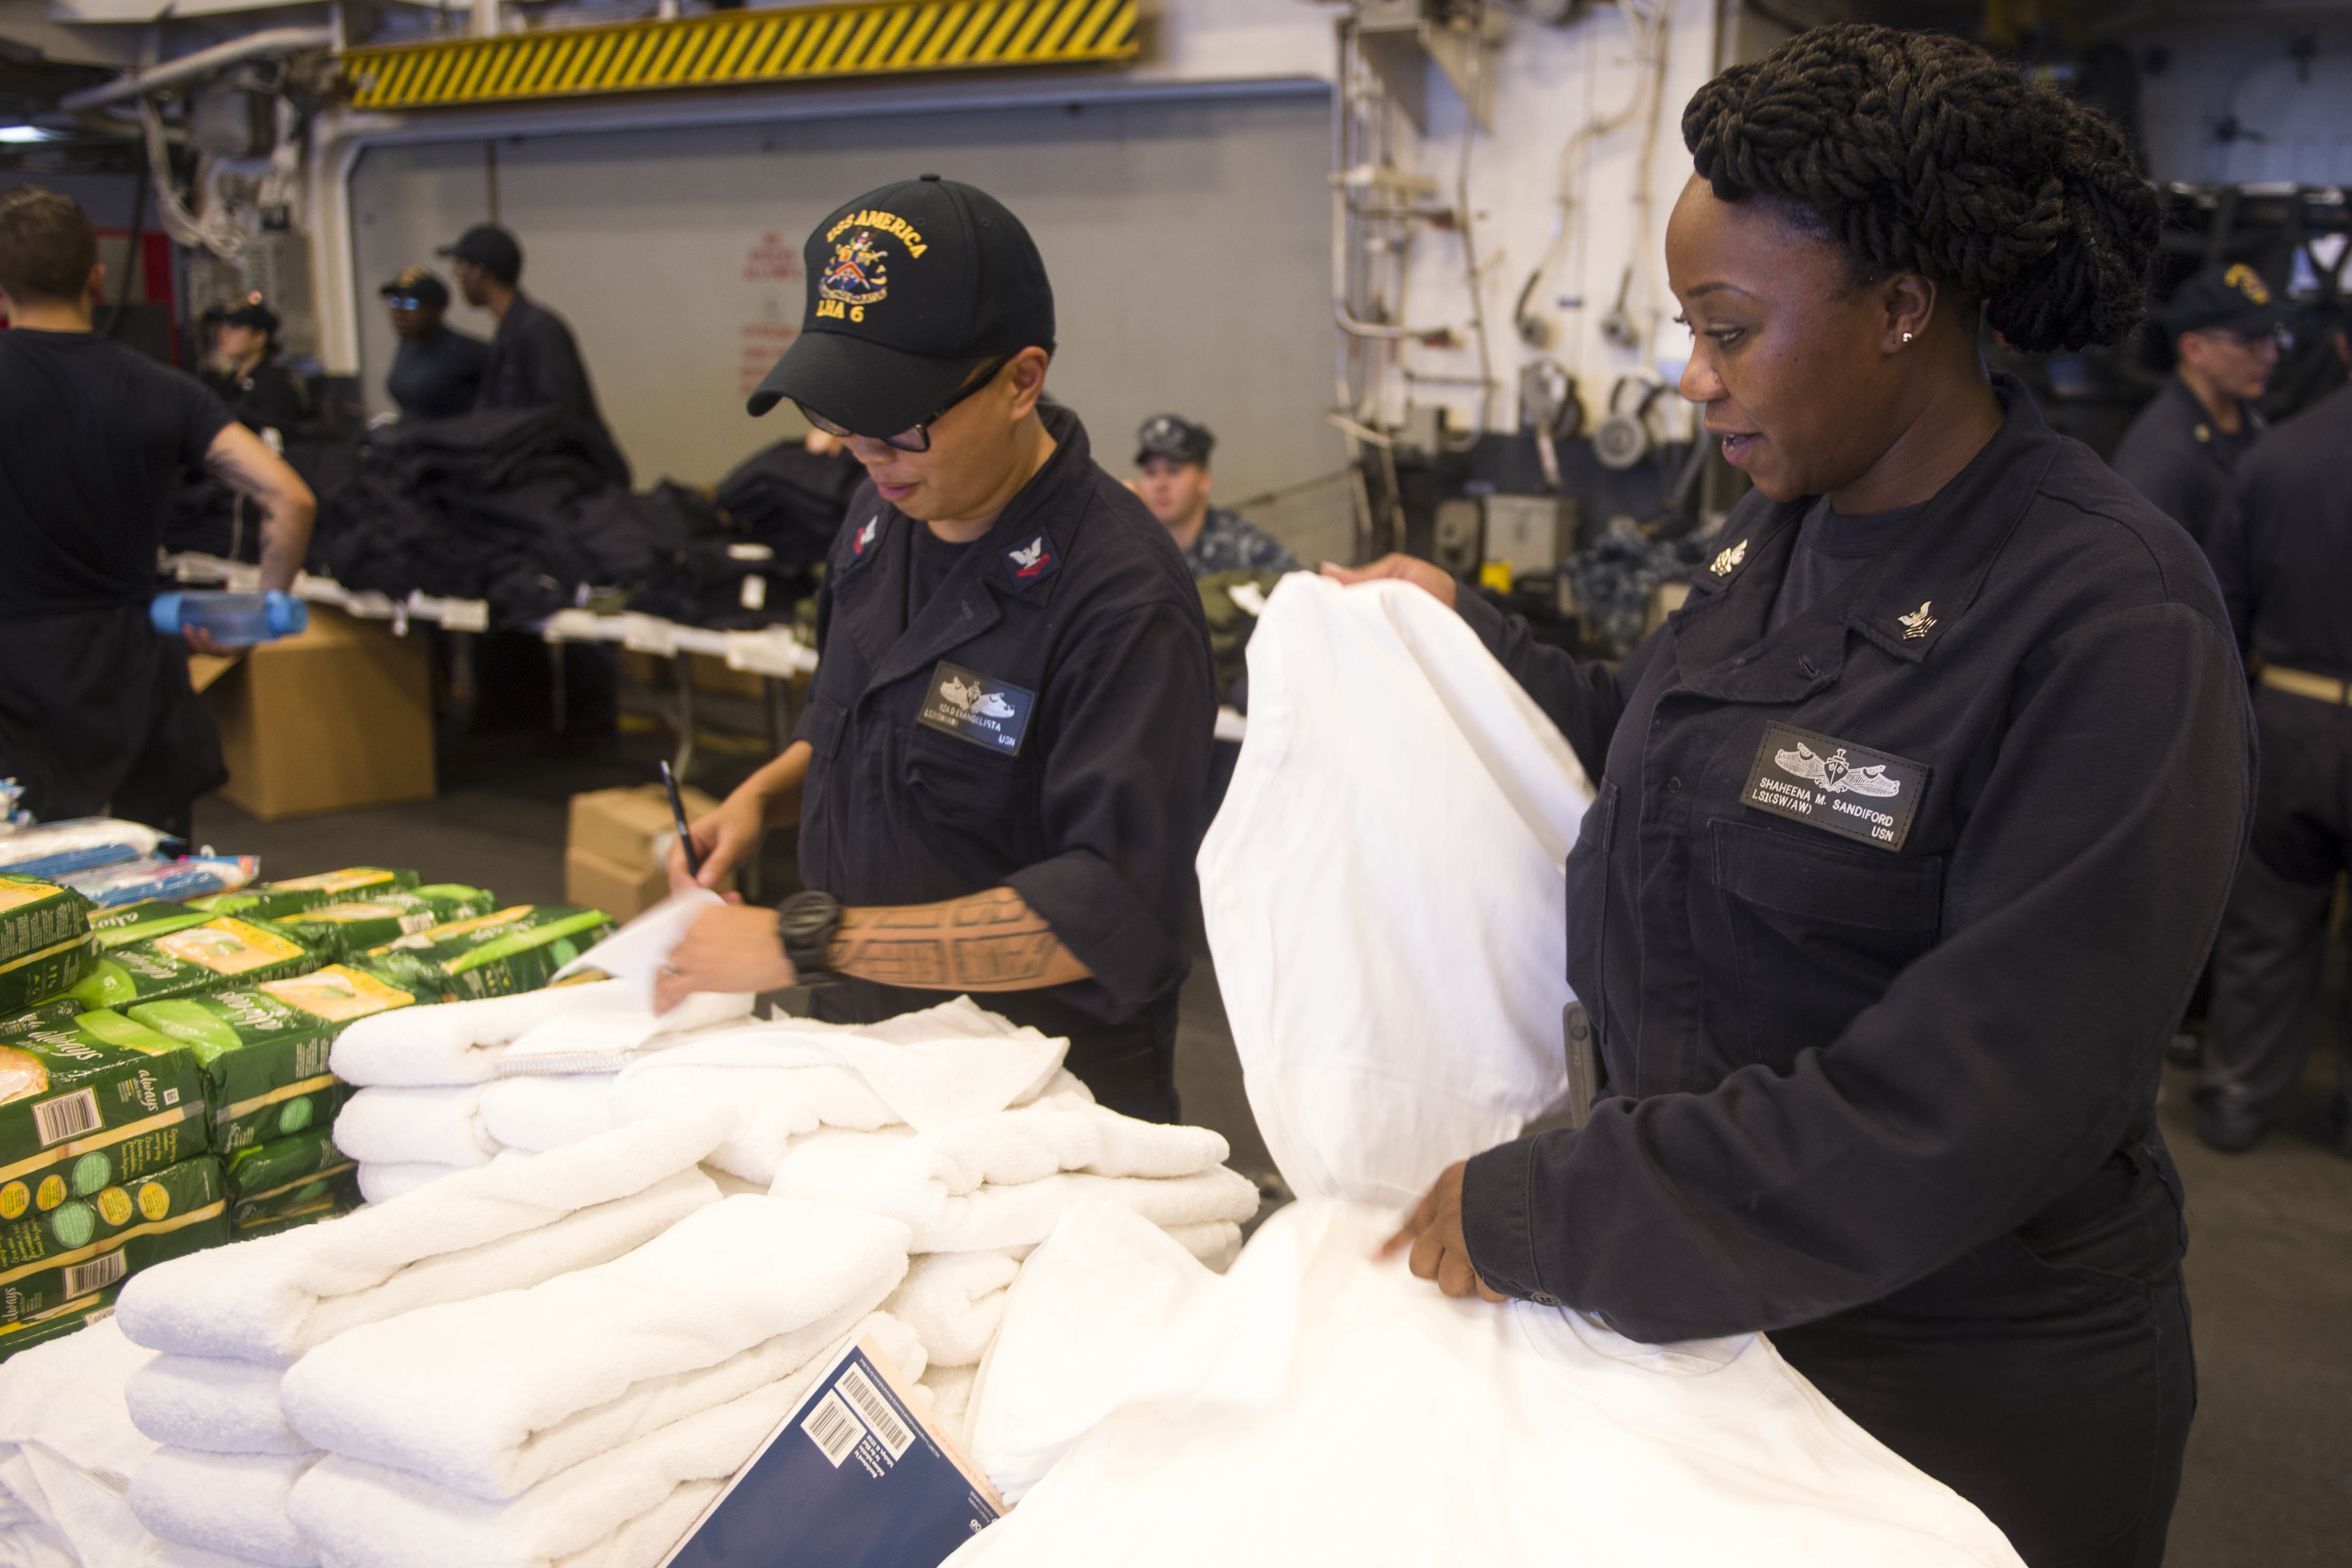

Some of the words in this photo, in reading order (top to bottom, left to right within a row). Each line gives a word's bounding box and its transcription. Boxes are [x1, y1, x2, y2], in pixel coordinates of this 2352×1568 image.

[826, 213, 855, 243] USS
[854, 210, 928, 259] AMERICA
[816, 300, 845, 318] LHA
[850, 306, 864, 323] 6
[999, 734, 1015, 747] USN
[1752, 789, 1812, 815] LS1(SW/AW)
[1760, 777, 1811, 801] SHAHEENA
[1815, 794, 1827, 805] M.
[1832, 799, 1894, 827] SANDIFORD
[1871, 826, 1894, 842] USN
[211, 991, 283, 1030] always
[27, 1029, 104, 1061] always
[138, 1069, 158, 1111] always
[1, 1288, 22, 1322] always
